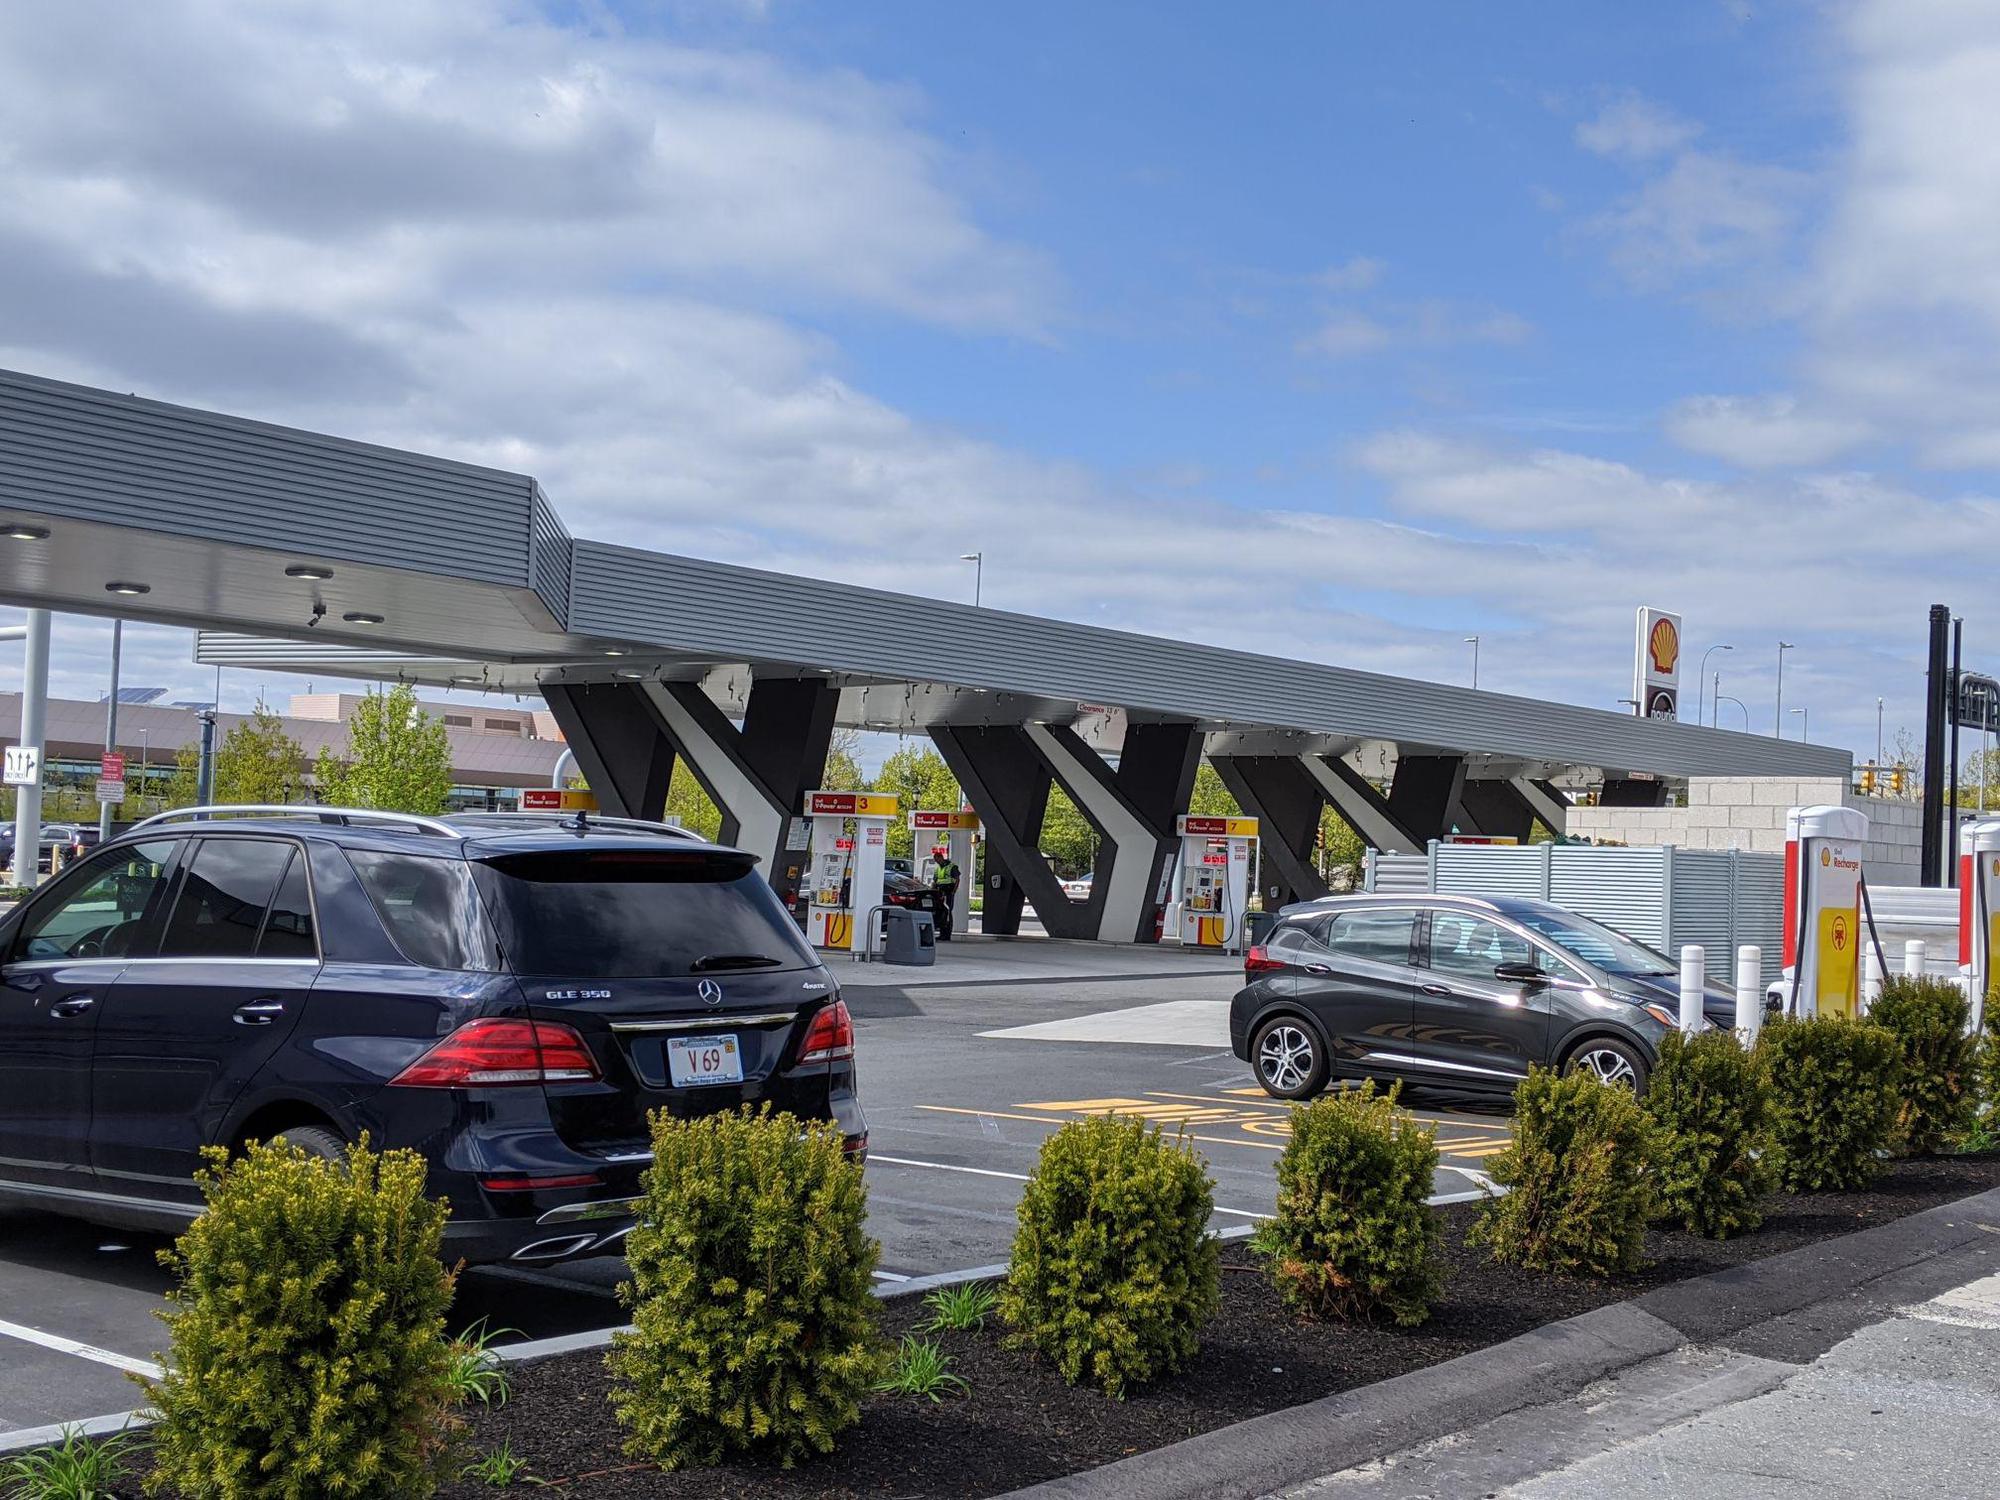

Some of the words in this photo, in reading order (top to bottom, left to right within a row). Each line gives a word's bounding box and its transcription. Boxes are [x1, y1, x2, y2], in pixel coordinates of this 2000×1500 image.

[1080, 703, 1104, 713] Clearance
[860, 797, 868, 809] 3
[953, 815, 959, 824] 5
[1231, 822, 1238, 830] 7
[1834, 857, 1859, 871] Recharge
[546, 991, 577, 999] GLE
[580, 990, 611, 998] 350
[688, 1050, 697, 1073] V
[703, 1049, 720, 1072] 69
